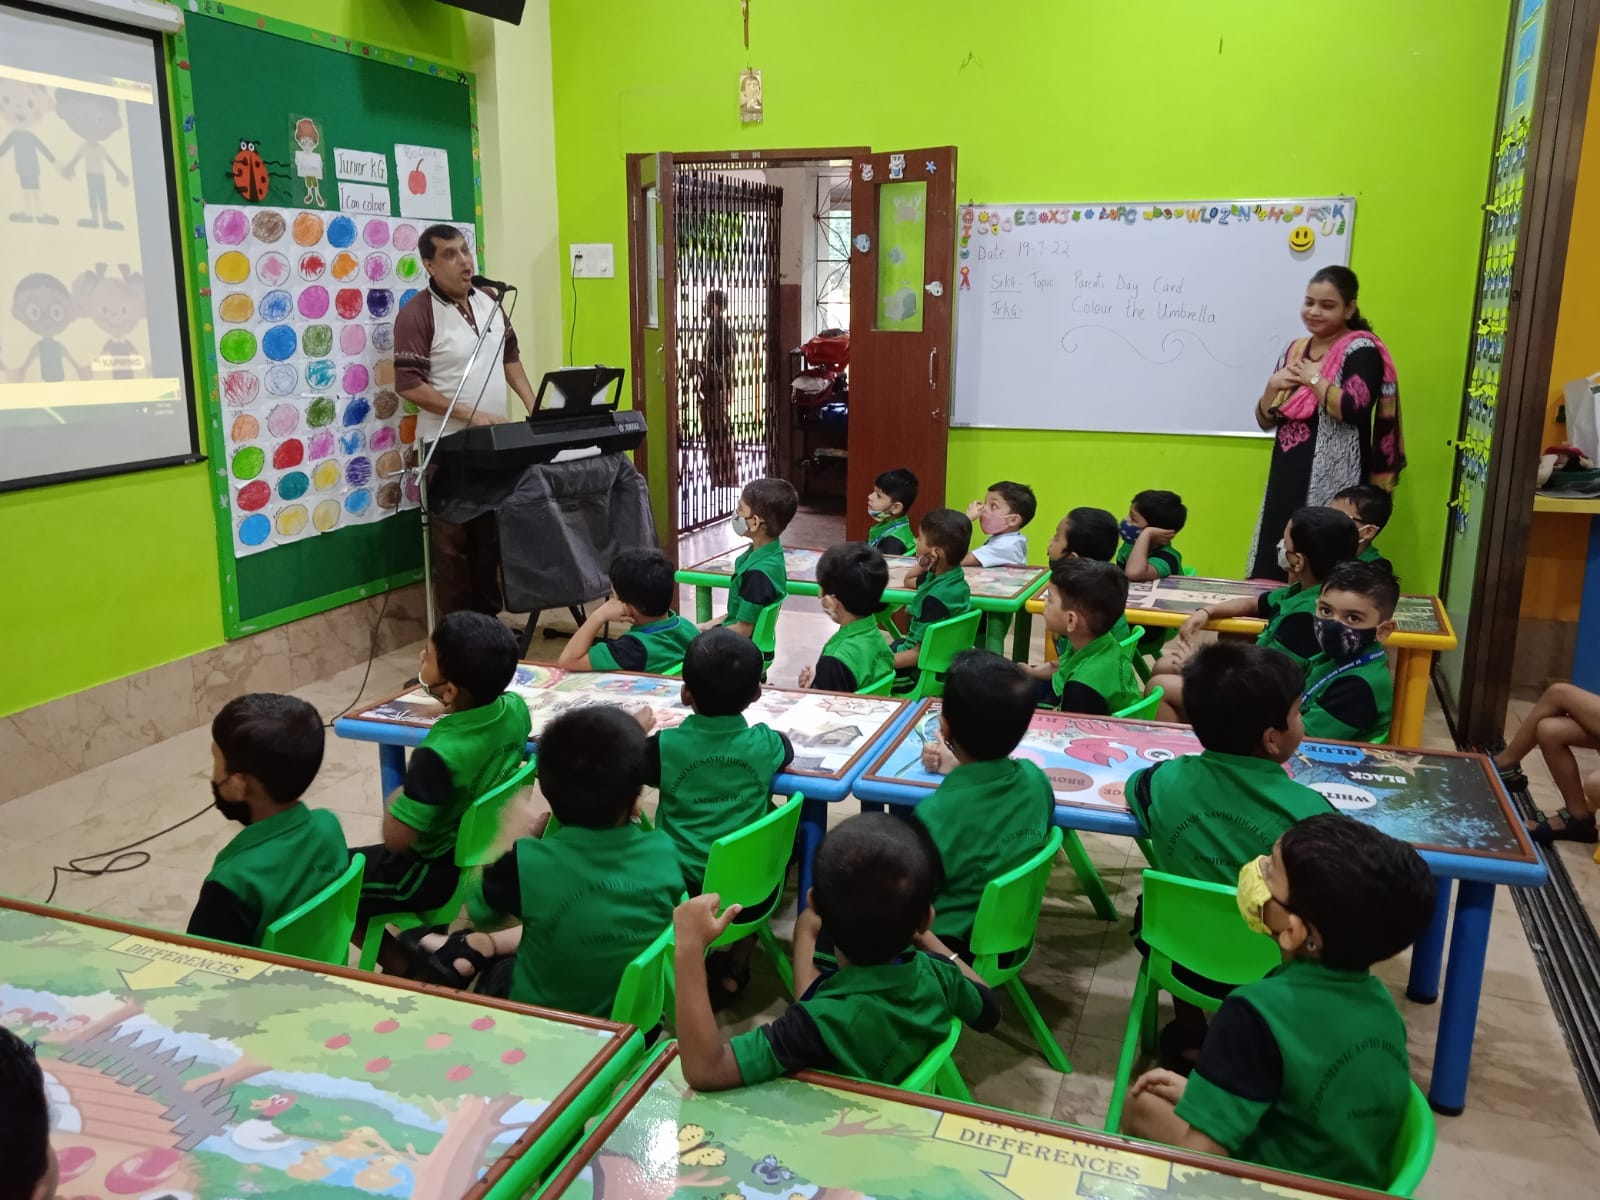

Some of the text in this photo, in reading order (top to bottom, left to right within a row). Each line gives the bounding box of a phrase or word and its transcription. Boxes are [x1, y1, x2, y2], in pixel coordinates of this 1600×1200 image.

[338, 152, 385, 180] Junior KG
[363, 193, 386, 212] colour
[978, 240, 1005, 261] Date
[1116, 273, 1139, 298] Day
[1153, 275, 1185, 294] Card
[1072, 295, 1216, 324] Colour the Umbrella
[1304, 744, 1358, 757] BLUE
[1049, 775, 1086, 788] BROW
[1348, 770, 1407, 785] BLACK
[1325, 791, 1370, 804] WHIT
[125, 943, 244, 974] DIFFERENCES
[959, 1127, 1141, 1181] DIFFERENCES
